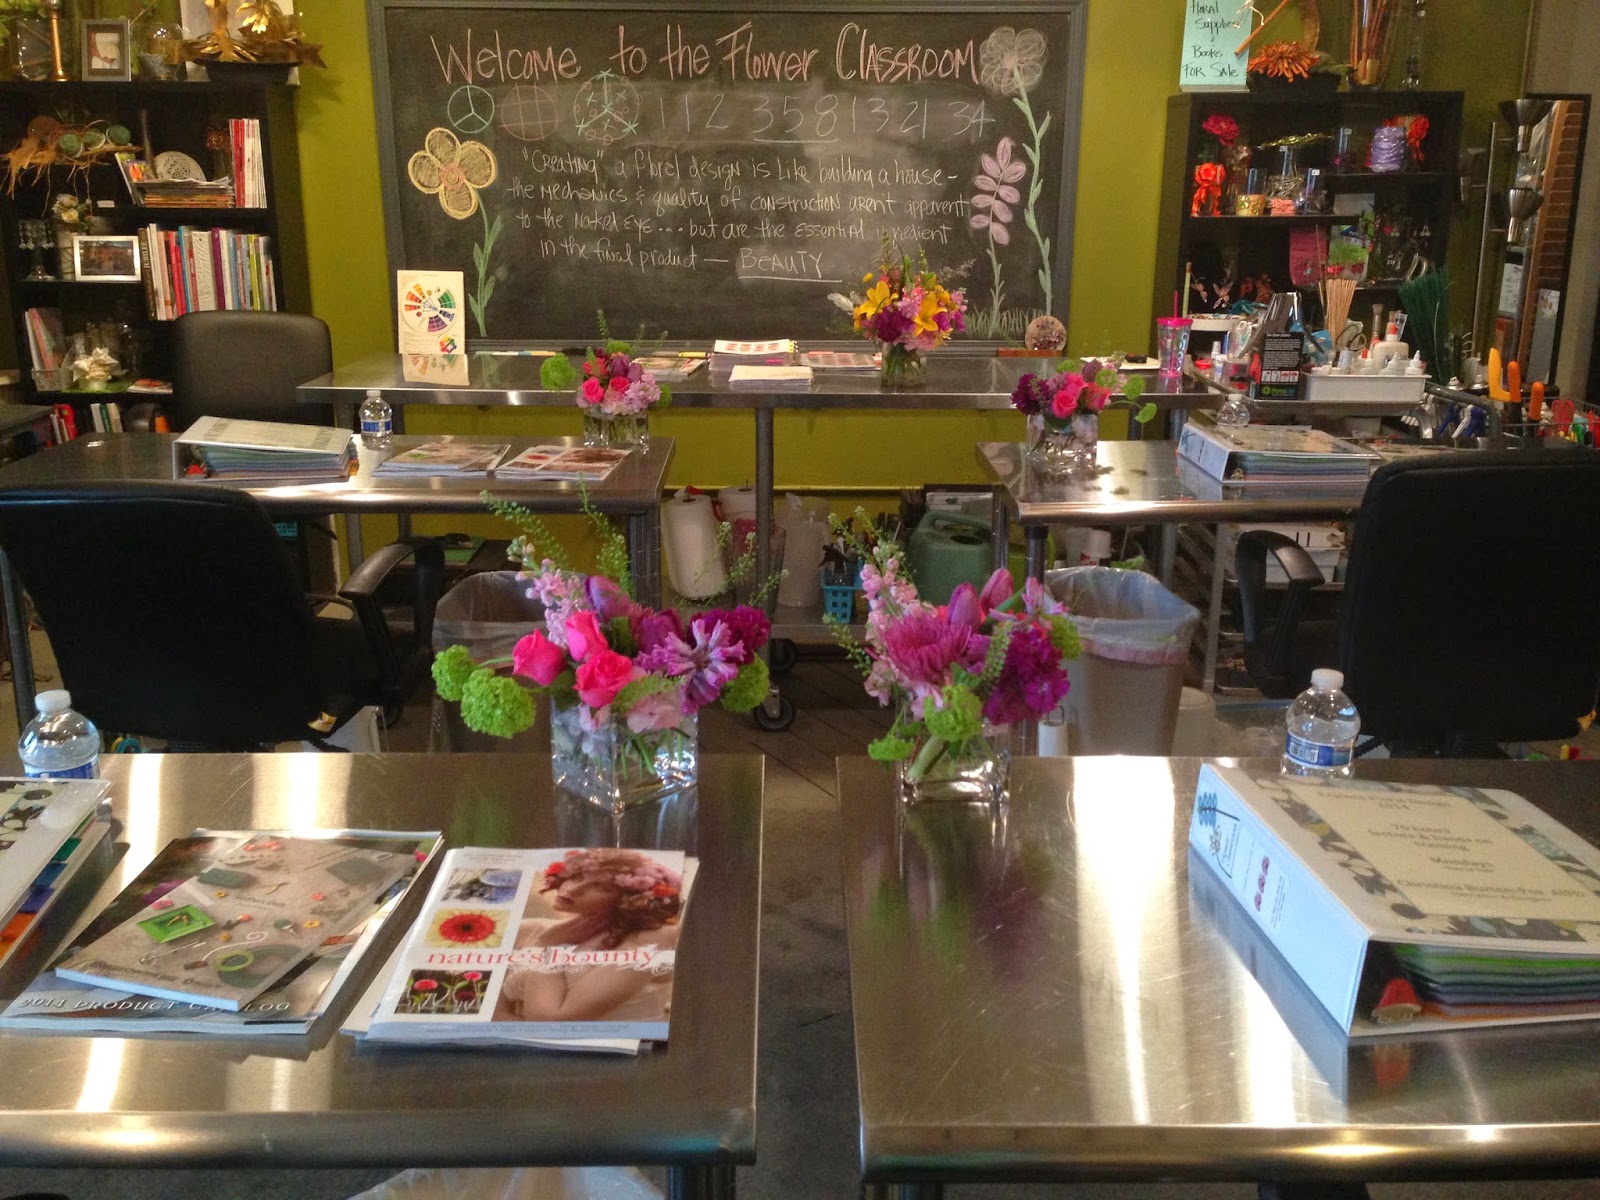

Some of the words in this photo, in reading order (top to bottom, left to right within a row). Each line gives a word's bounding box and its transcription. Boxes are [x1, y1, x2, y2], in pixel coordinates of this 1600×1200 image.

[609, 25, 648, 75] to
[659, 24, 710, 81] the
[715, 22, 818, 82] Flower
[1192, 45, 1223, 59] Books
[615, 160, 627, 178] a
[751, 160, 771, 179] is
[818, 155, 874, 188] building
[878, 167, 890, 183] a
[506, 177, 534, 200] the
[653, 188, 712, 217] quality
[720, 187, 741, 209] of
[904, 194, 969, 219] apparent
[515, 208, 531, 229] to
[536, 207, 564, 229] the
[689, 217, 719, 238] but
[722, 223, 751, 240] are
[755, 218, 784, 238] the
[560, 236, 589, 260] the
[639, 245, 698, 273] product
[427, 949, 545, 965] nature's
[551, 948, 660, 968] bounty
[18, 997, 66, 1009] 2014
[72, 998, 179, 1012] PRODUCT
